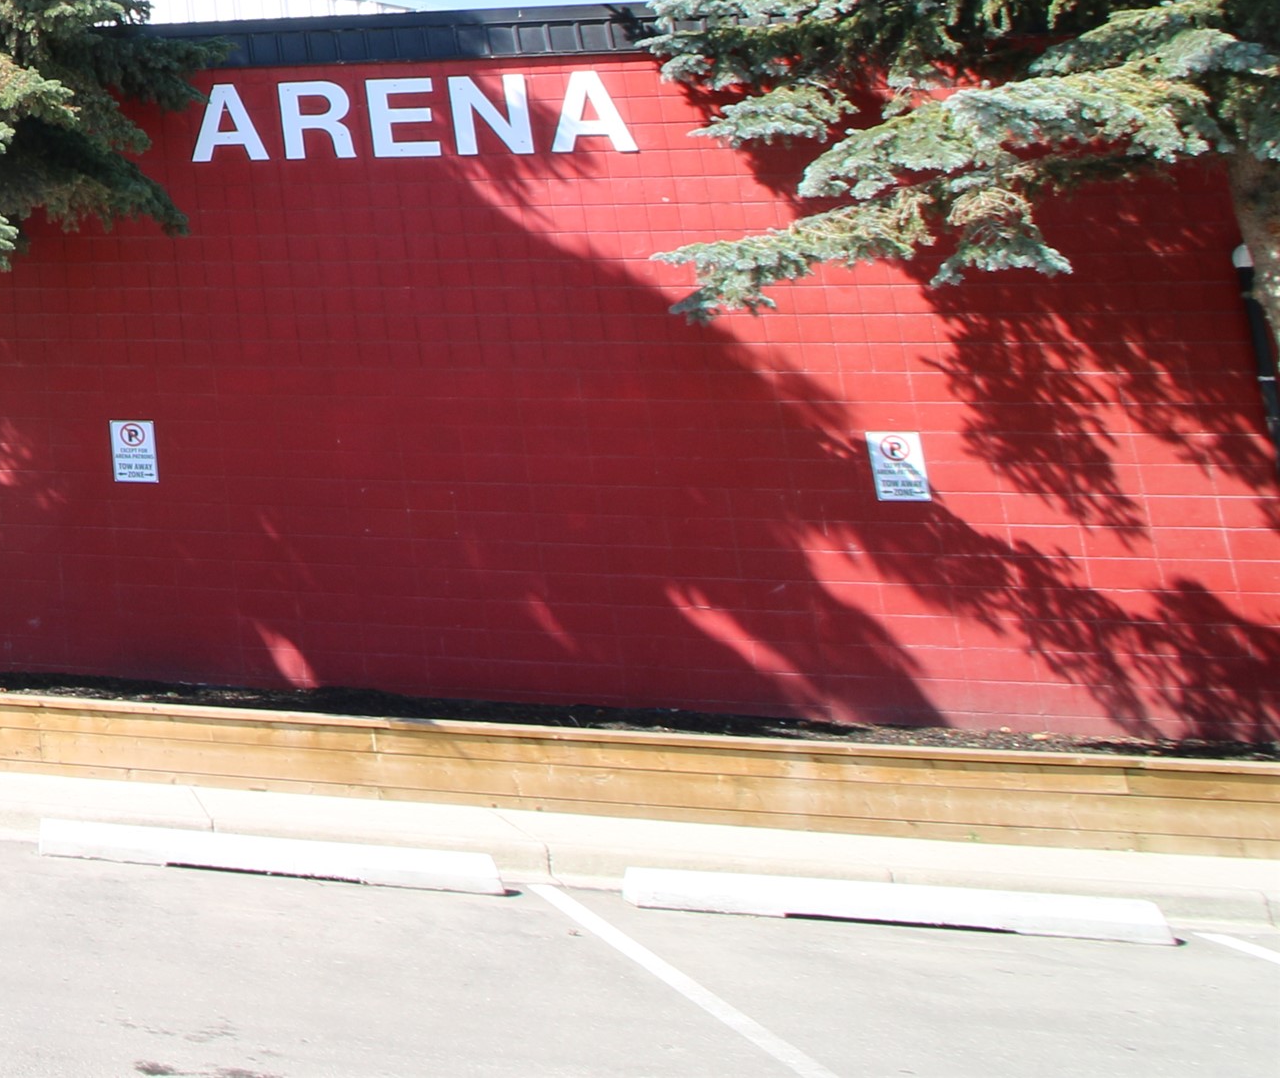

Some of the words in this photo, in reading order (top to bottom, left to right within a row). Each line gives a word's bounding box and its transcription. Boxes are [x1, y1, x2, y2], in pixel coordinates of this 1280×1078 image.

[192, 70, 639, 162] ARENA
[134, 463, 153, 471] AWAY
[881, 479, 899, 487] TOW
[900, 479, 922, 488] AWAY
[893, 488, 914, 496] ZONE
